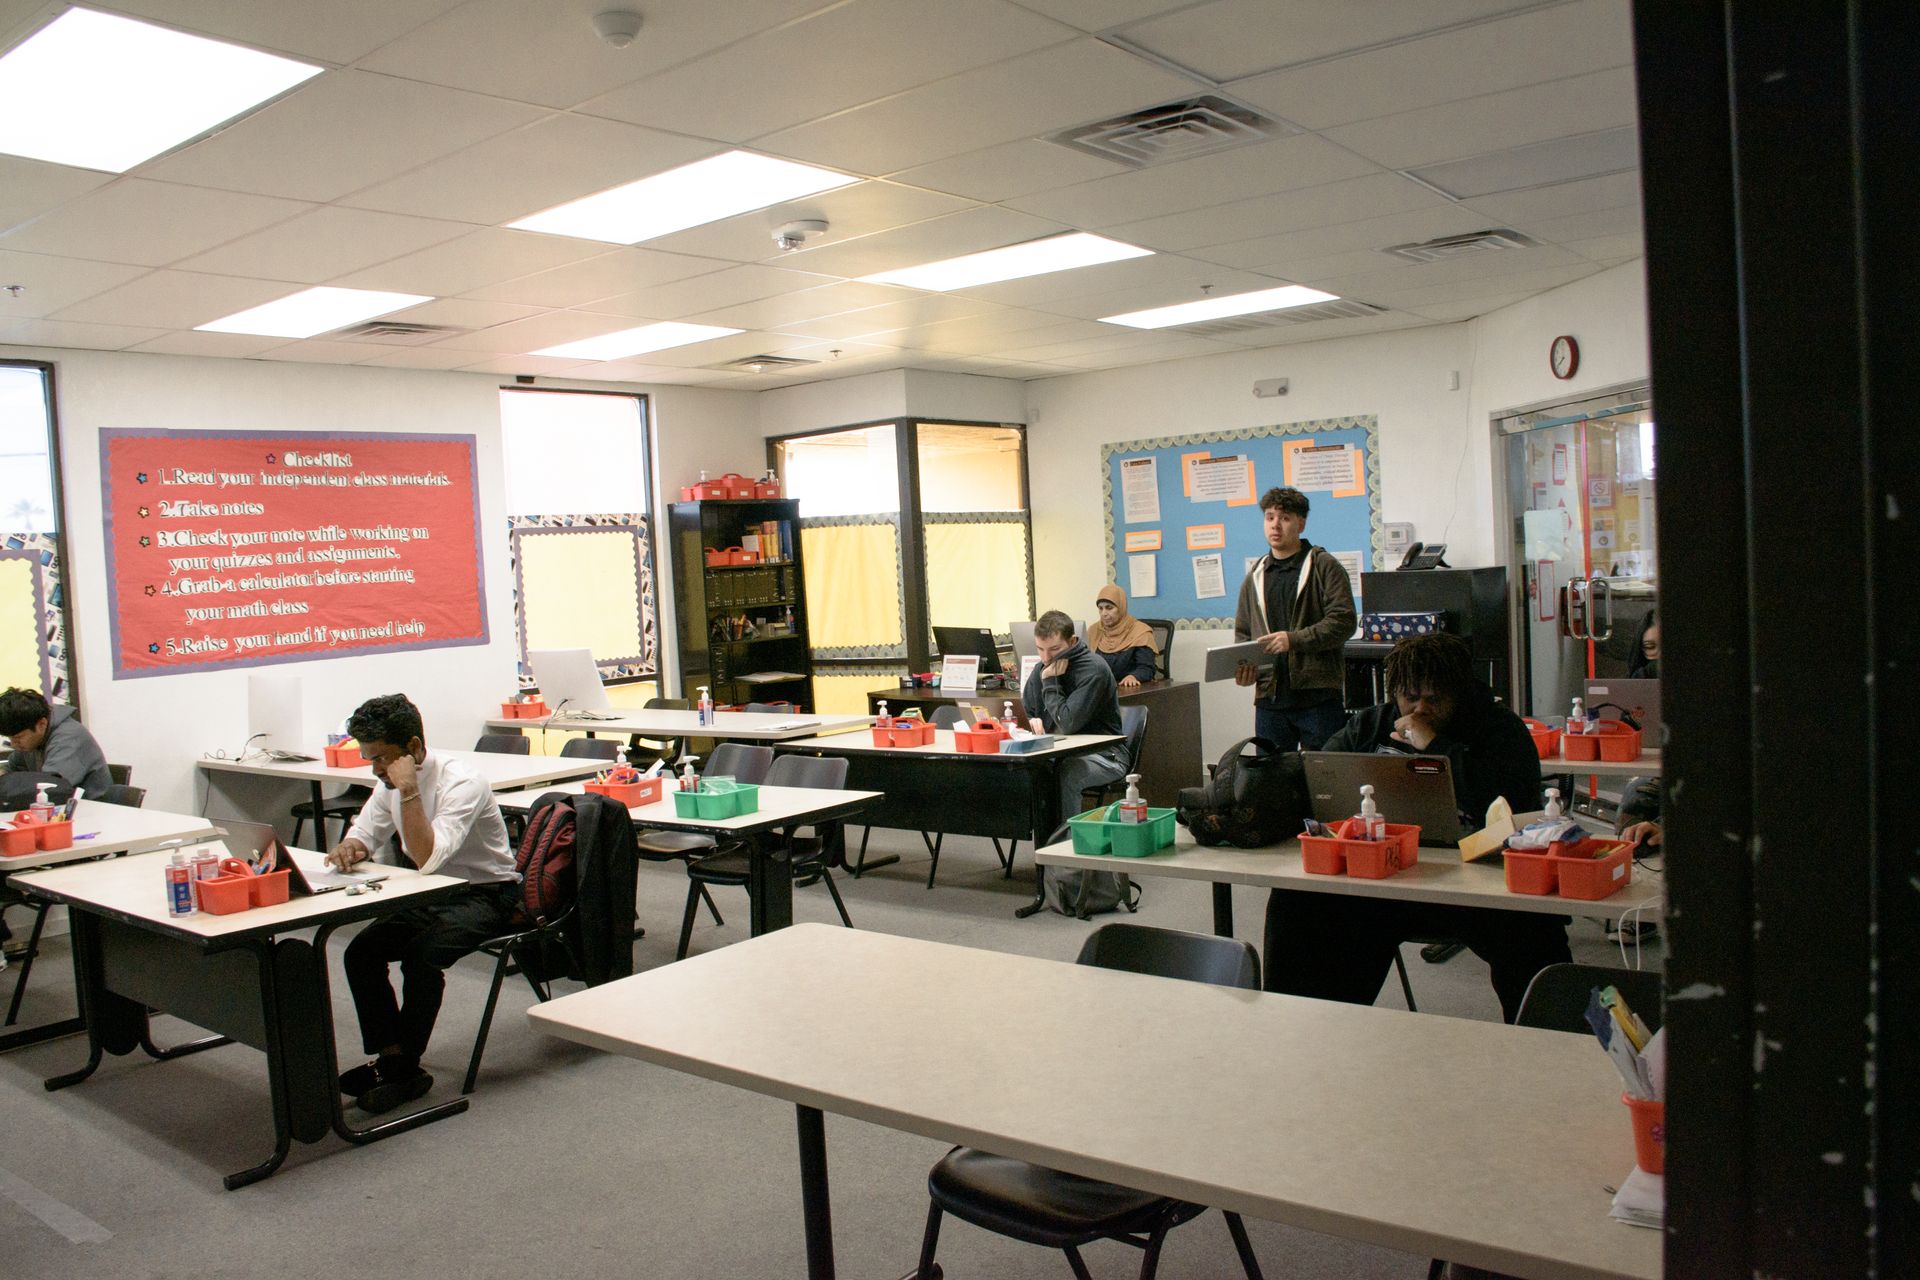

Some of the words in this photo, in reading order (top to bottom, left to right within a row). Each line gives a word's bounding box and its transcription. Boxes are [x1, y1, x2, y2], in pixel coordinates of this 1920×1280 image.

[282, 452, 352, 467] Checklist
[218, 472, 254, 488] your
[260, 470, 350, 489] independent
[353, 472, 388, 487] class
[222, 501, 264, 515] notes
[230, 531, 268, 549] your
[271, 528, 304, 542] note
[307, 525, 346, 541] while
[350, 525, 410, 542] working
[411, 527, 429, 539] on
[169, 557, 208, 575] your
[211, 552, 272, 573] quizzes
[276, 548, 304, 563] and
[307, 545, 400, 563] assignments.
[225, 579, 236, 591] a
[239, 572, 313, 589] calculator
[314, 569, 361, 586] before
[363, 567, 415, 583] starting
[185, 607, 224, 625] your
[228, 600, 268, 618] math
[270, 599, 309, 615] class
[234, 634, 272, 653] your
[273, 627, 312, 645] hand
[314, 626, 327, 642] if
[329, 629, 358, 645] you
[359, 621, 393, 639] need
[395, 618, 425, 637] help
